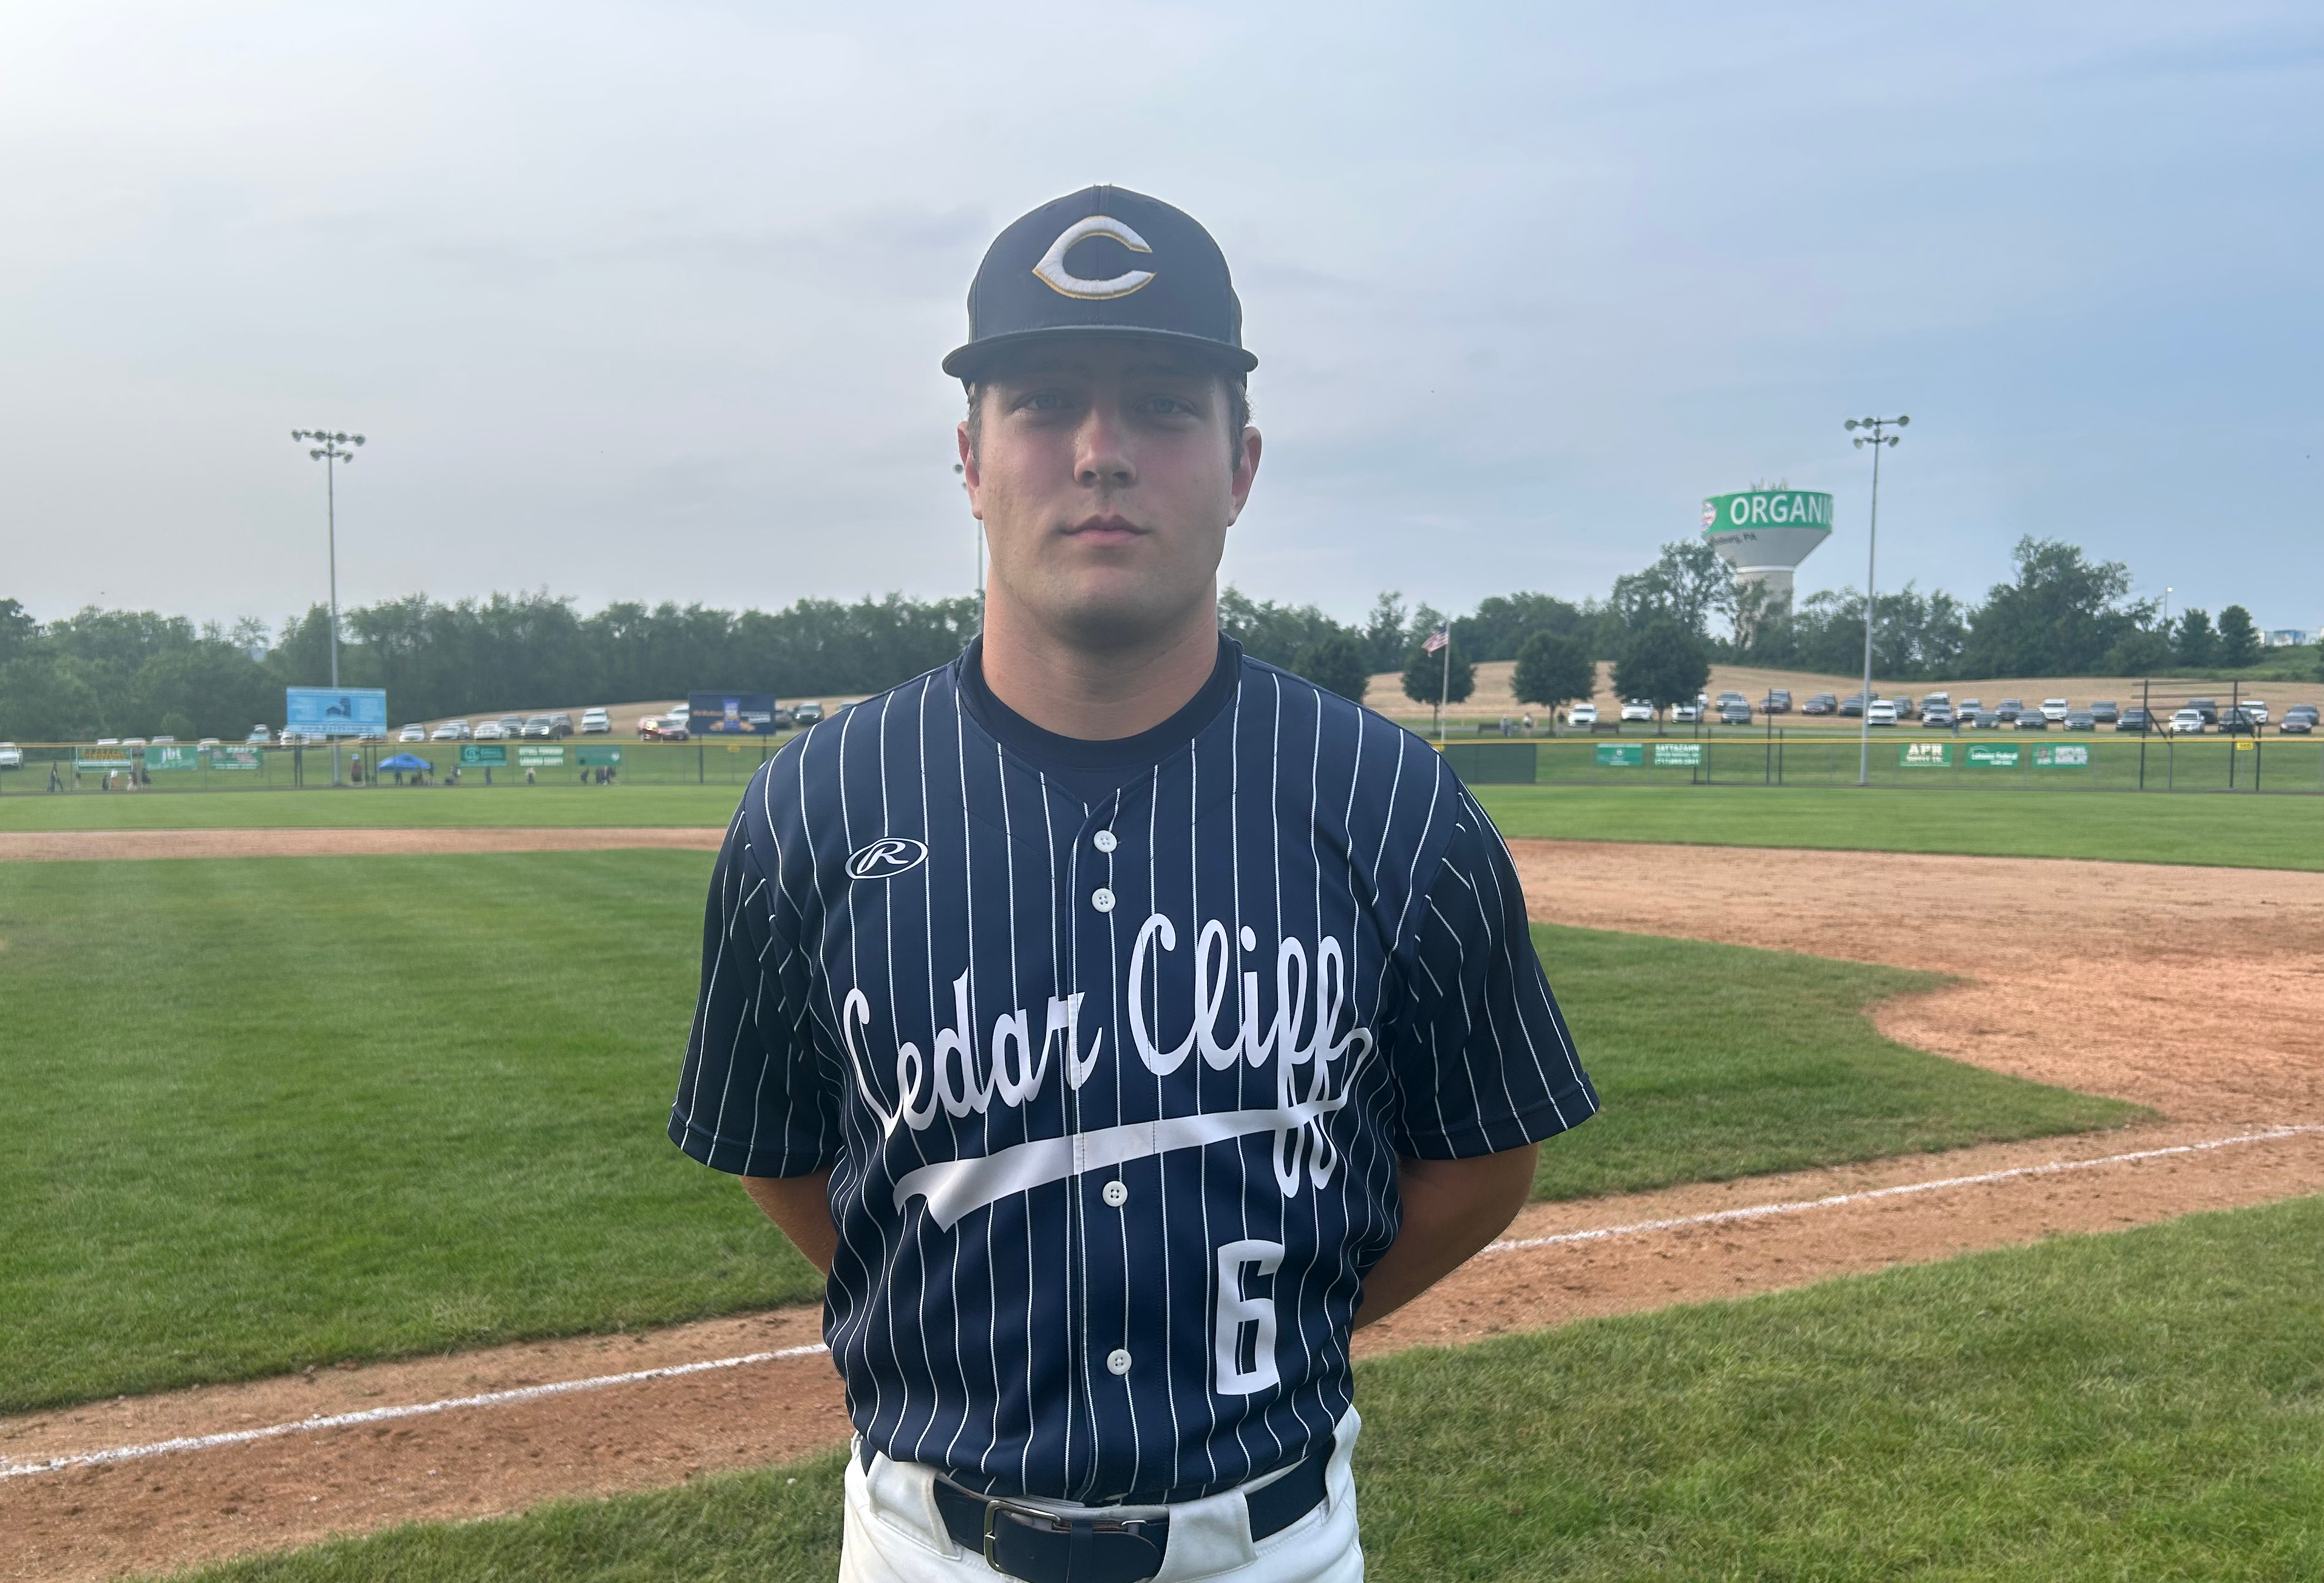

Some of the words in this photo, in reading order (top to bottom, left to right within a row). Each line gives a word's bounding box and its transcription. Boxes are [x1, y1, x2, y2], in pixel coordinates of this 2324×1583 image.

[1032, 215, 1157, 300] C
[843, 966, 1103, 1140] Cedar
[1128, 913, 1373, 1198] Cliff
[1215, 1239, 1285, 1395] 6
